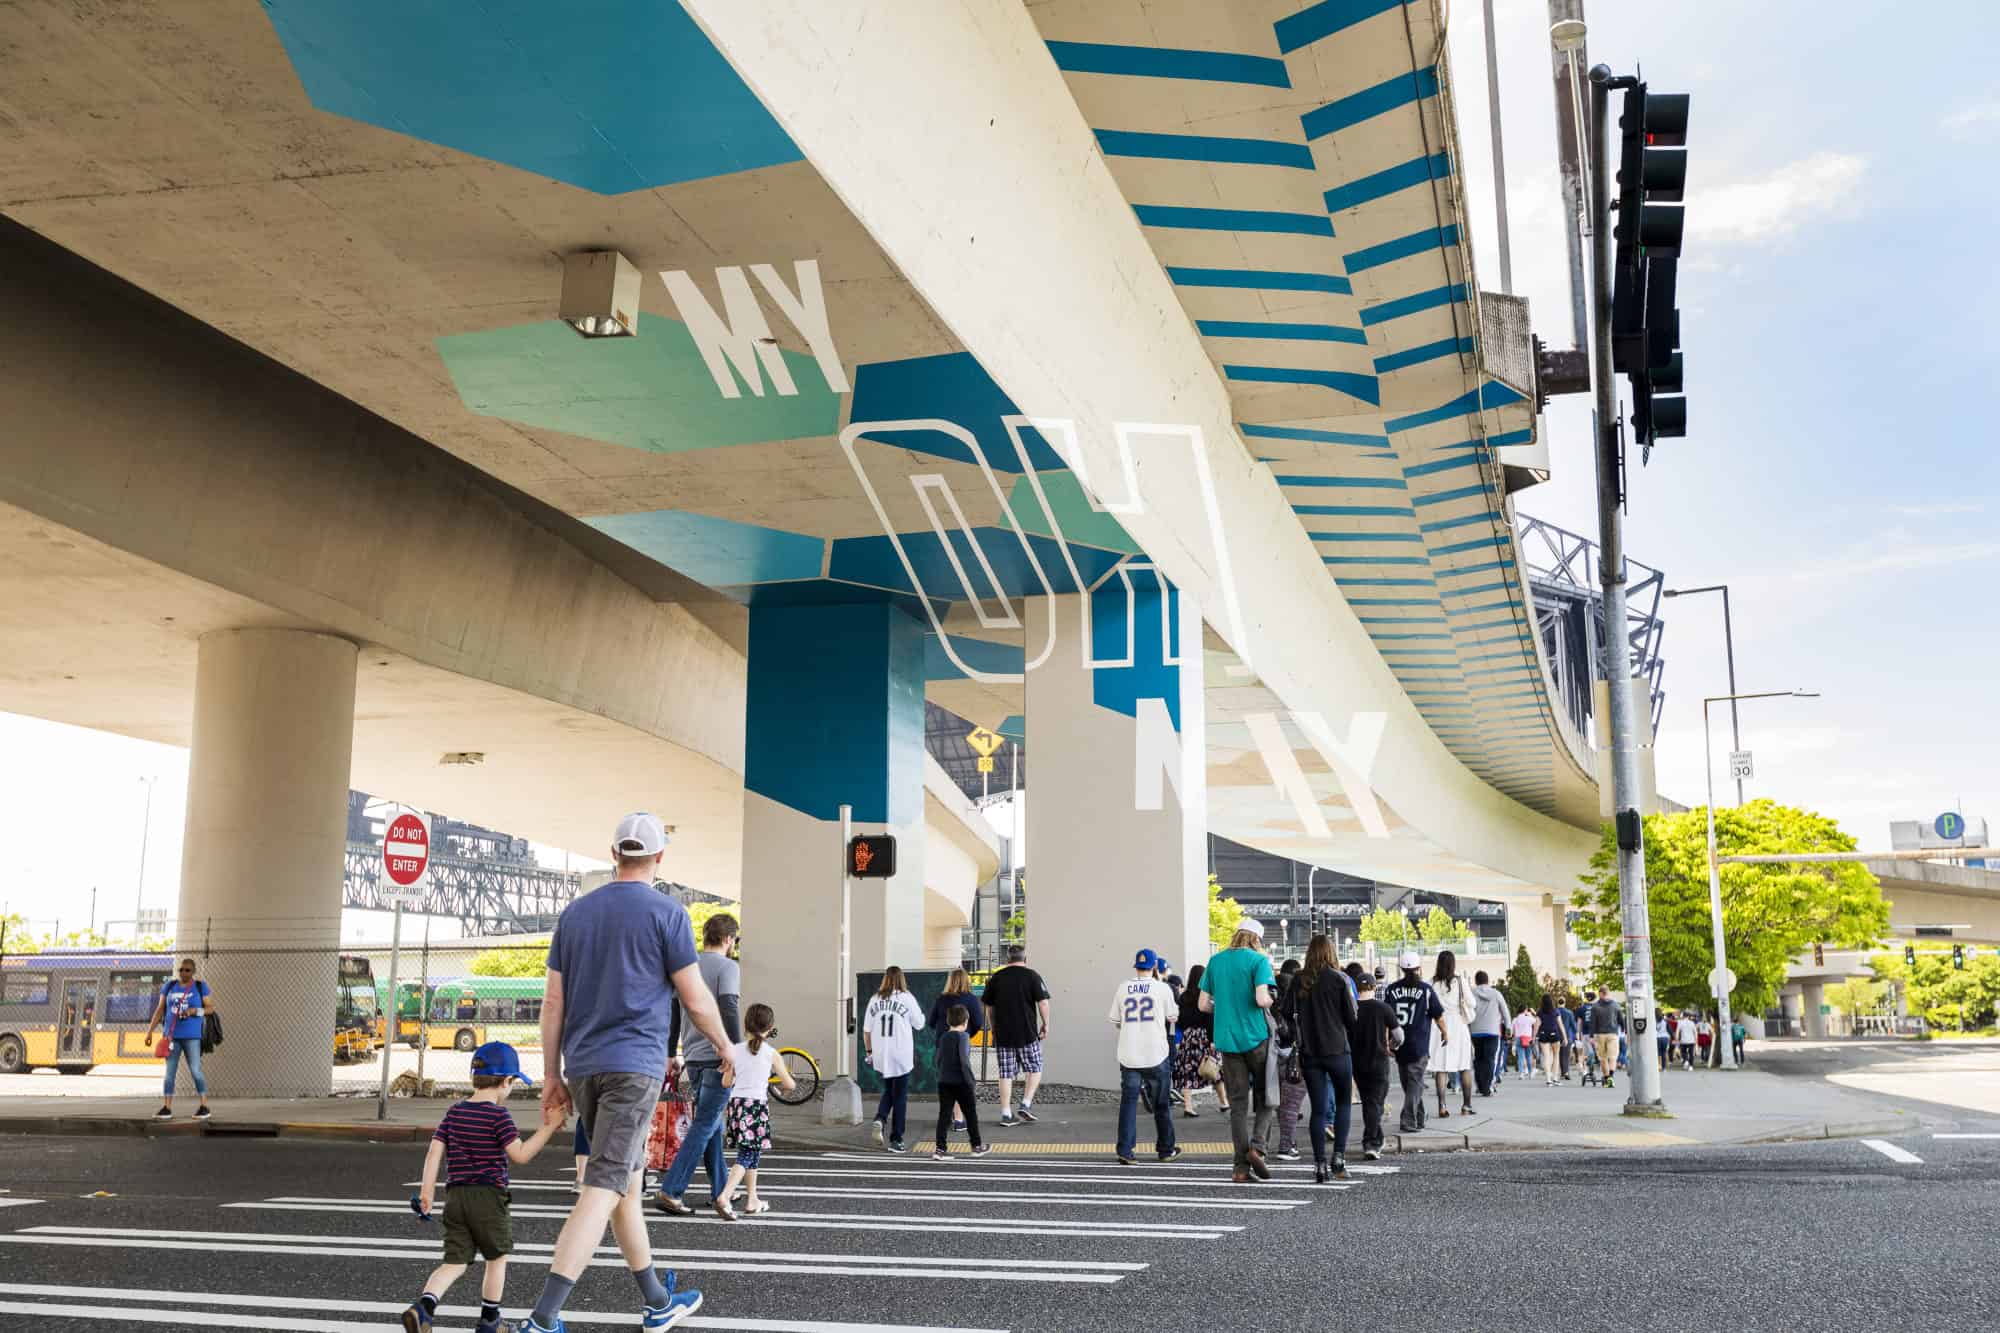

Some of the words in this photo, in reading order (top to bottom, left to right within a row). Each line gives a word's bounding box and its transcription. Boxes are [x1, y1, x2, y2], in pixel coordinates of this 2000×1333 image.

[658, 259, 851, 399] MY
[838, 414, 1256, 684] OH
[1734, 766, 1750, 776] 30
[393, 826, 405, 839] DO
[407, 828, 423, 841] NOT
[1943, 815, 1955, 837] P
[392, 859, 418, 872] ENTER
[1391, 986, 1424, 1000] ICHIRO
[870, 999, 909, 1018] MARTINEZ
[1123, 996, 1154, 1022] 22
[1396, 1002, 1417, 1026] 51
[881, 1013, 894, 1037] 11
